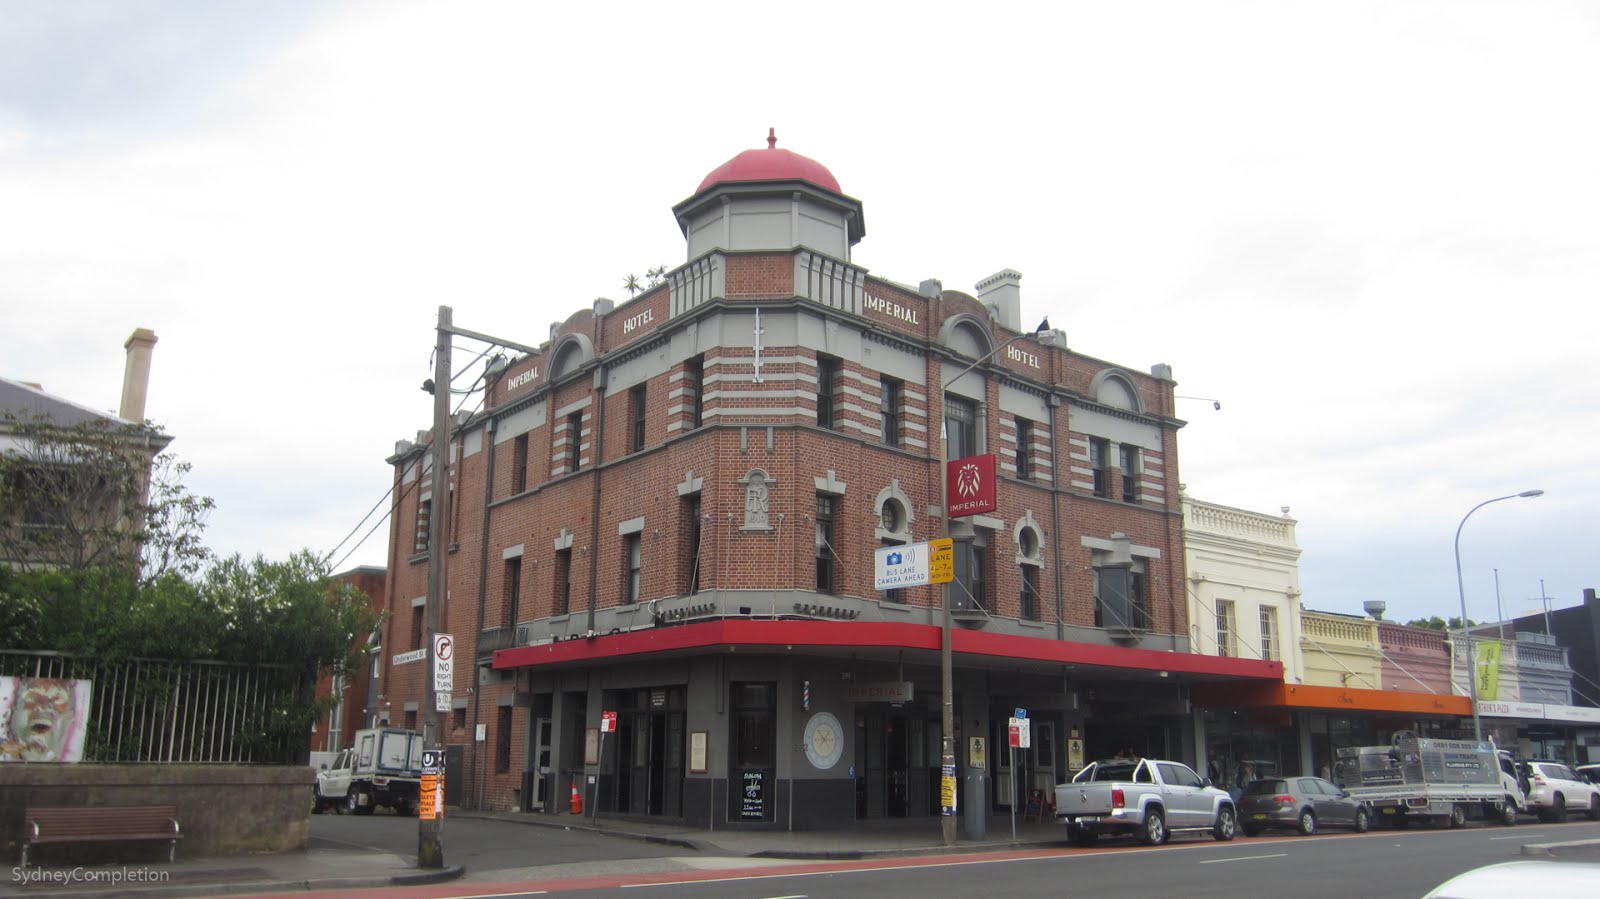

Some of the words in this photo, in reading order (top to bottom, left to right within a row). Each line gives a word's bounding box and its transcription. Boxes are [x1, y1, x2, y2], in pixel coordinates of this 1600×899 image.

[864, 292, 919, 325] IMPERIAL
[623, 308, 654, 334] HOTEL
[1007, 344, 1040, 369] HOTEL
[507, 366, 539, 392] IMPERIAL
[950, 499, 989, 512] IMPERIAL
[931, 554, 951, 563] LANE
[900, 566, 916, 575] LANE
[877, 576, 902, 585] CAMERA
[904, 573, 925, 582] AHEAD
[393, 652, 418, 663] Underwood
[439, 663, 450, 671] NO
